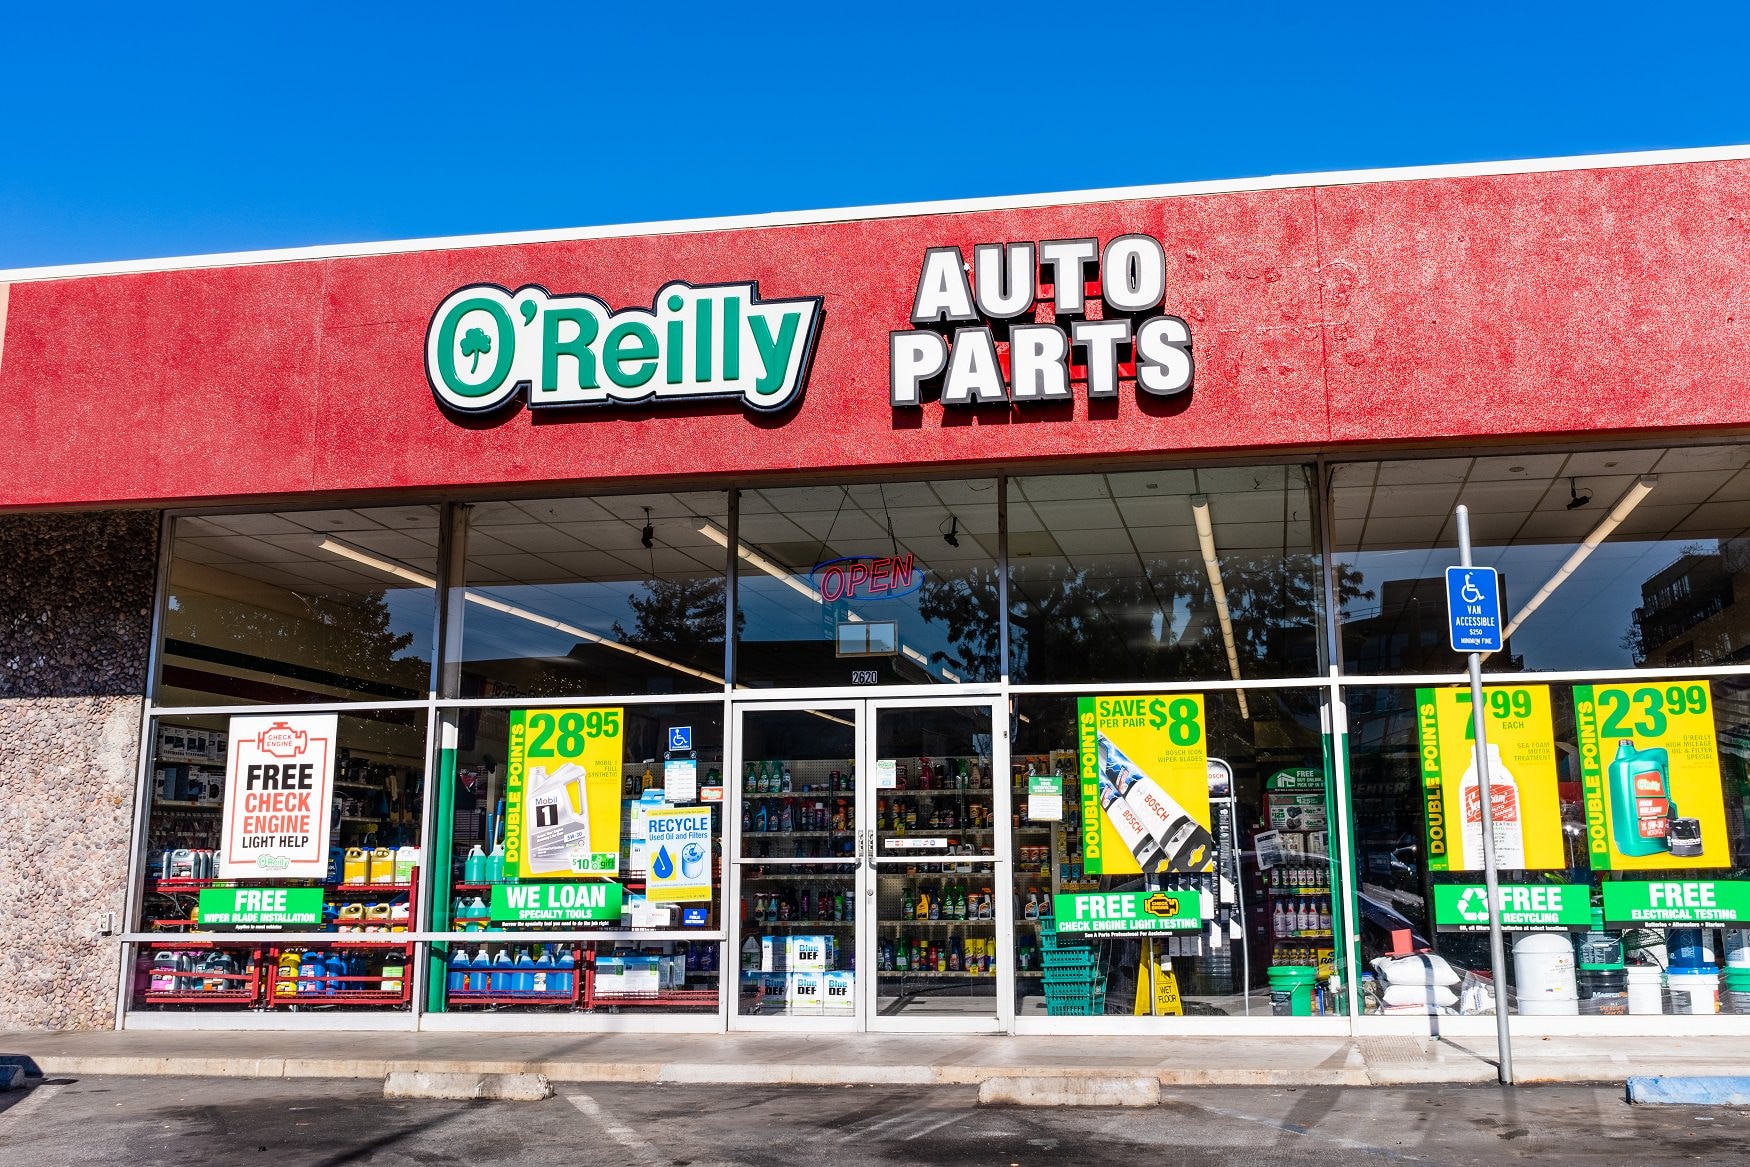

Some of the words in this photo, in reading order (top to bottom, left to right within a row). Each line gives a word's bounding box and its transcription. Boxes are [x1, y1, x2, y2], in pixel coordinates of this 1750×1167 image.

[910, 233, 1166, 322] AUTO
[437, 294, 802, 398] O'Reilly
[889, 315, 1195, 407] PARTS
[820, 553, 914, 602] OPEN
[1467, 606, 1482, 614] VAN
[1456, 617, 1495, 626] ACCESSIBLE
[852, 670, 878, 684] 2620
[1100, 700, 1146, 717] SAVE
[1100, 719, 1119, 728] PER
[1123, 718, 1145, 727] PAIR
[1149, 698, 1200, 746] $8
[1081, 712, 1096, 778] POINTS
[1420, 704, 1439, 771] POINTS
[1578, 701, 1599, 770] POINTS
[509, 723, 524, 786] POINTS
[247, 764, 313, 790] FREE
[245, 792, 311, 813] CHECK
[536, 796, 557, 805] Mobil
[1144, 794, 1170, 822] BOSCH
[542, 806, 551, 826] 1
[1084, 784, 1100, 858] DOUBLE
[1122, 810, 1144, 834] BOSCH
[1426, 777, 1444, 854] DOUBLE
[1586, 775, 1607, 853] DOUBLE
[243, 815, 310, 833] ENGINE
[506, 792, 521, 862] DOUBLE
[649, 817, 708, 832] RECYCLE
[242, 836, 275, 848] LIGHT
[279, 836, 308, 847] HELP
[567, 832, 582, 840] 5W-30
[258, 855, 290, 868] O'Reilly
[572, 859, 589, 869] $10
[601, 860, 615, 870] gift
[235, 890, 287, 912] FREE
[506, 886, 540, 908] WE
[548, 885, 606, 907] LOAN
[1498, 886, 1563, 911] FREE
[1648, 883, 1716, 907] FREE
[519, 910, 563, 919] SPECIALTY
[566, 909, 592, 918] TOOLS
[1075, 895, 1136, 919] FREE
[1632, 909, 1692, 919] ELECTRICAL
[1694, 909, 1736, 919] TESTING
[204, 914, 229, 923] WIPER
[232, 913, 258, 923] BLADE
[260, 913, 315, 923] INSTALLATION
[1060, 921, 1090, 931] CHECK
[1093, 920, 1126, 930] ENGINE
[1130, 919, 1156, 929] LIGHT
[1158, 918, 1198, 928] TESTING
[1504, 913, 1559, 923] RECYCLING
[800, 952, 818, 960] DEF
[765, 987, 784, 995] DEF
[798, 979, 817, 987] Blue
[828, 980, 847, 988] Blue
[1160, 986, 1171, 994] WET
[1158, 995, 1176, 1003] FLOOR
